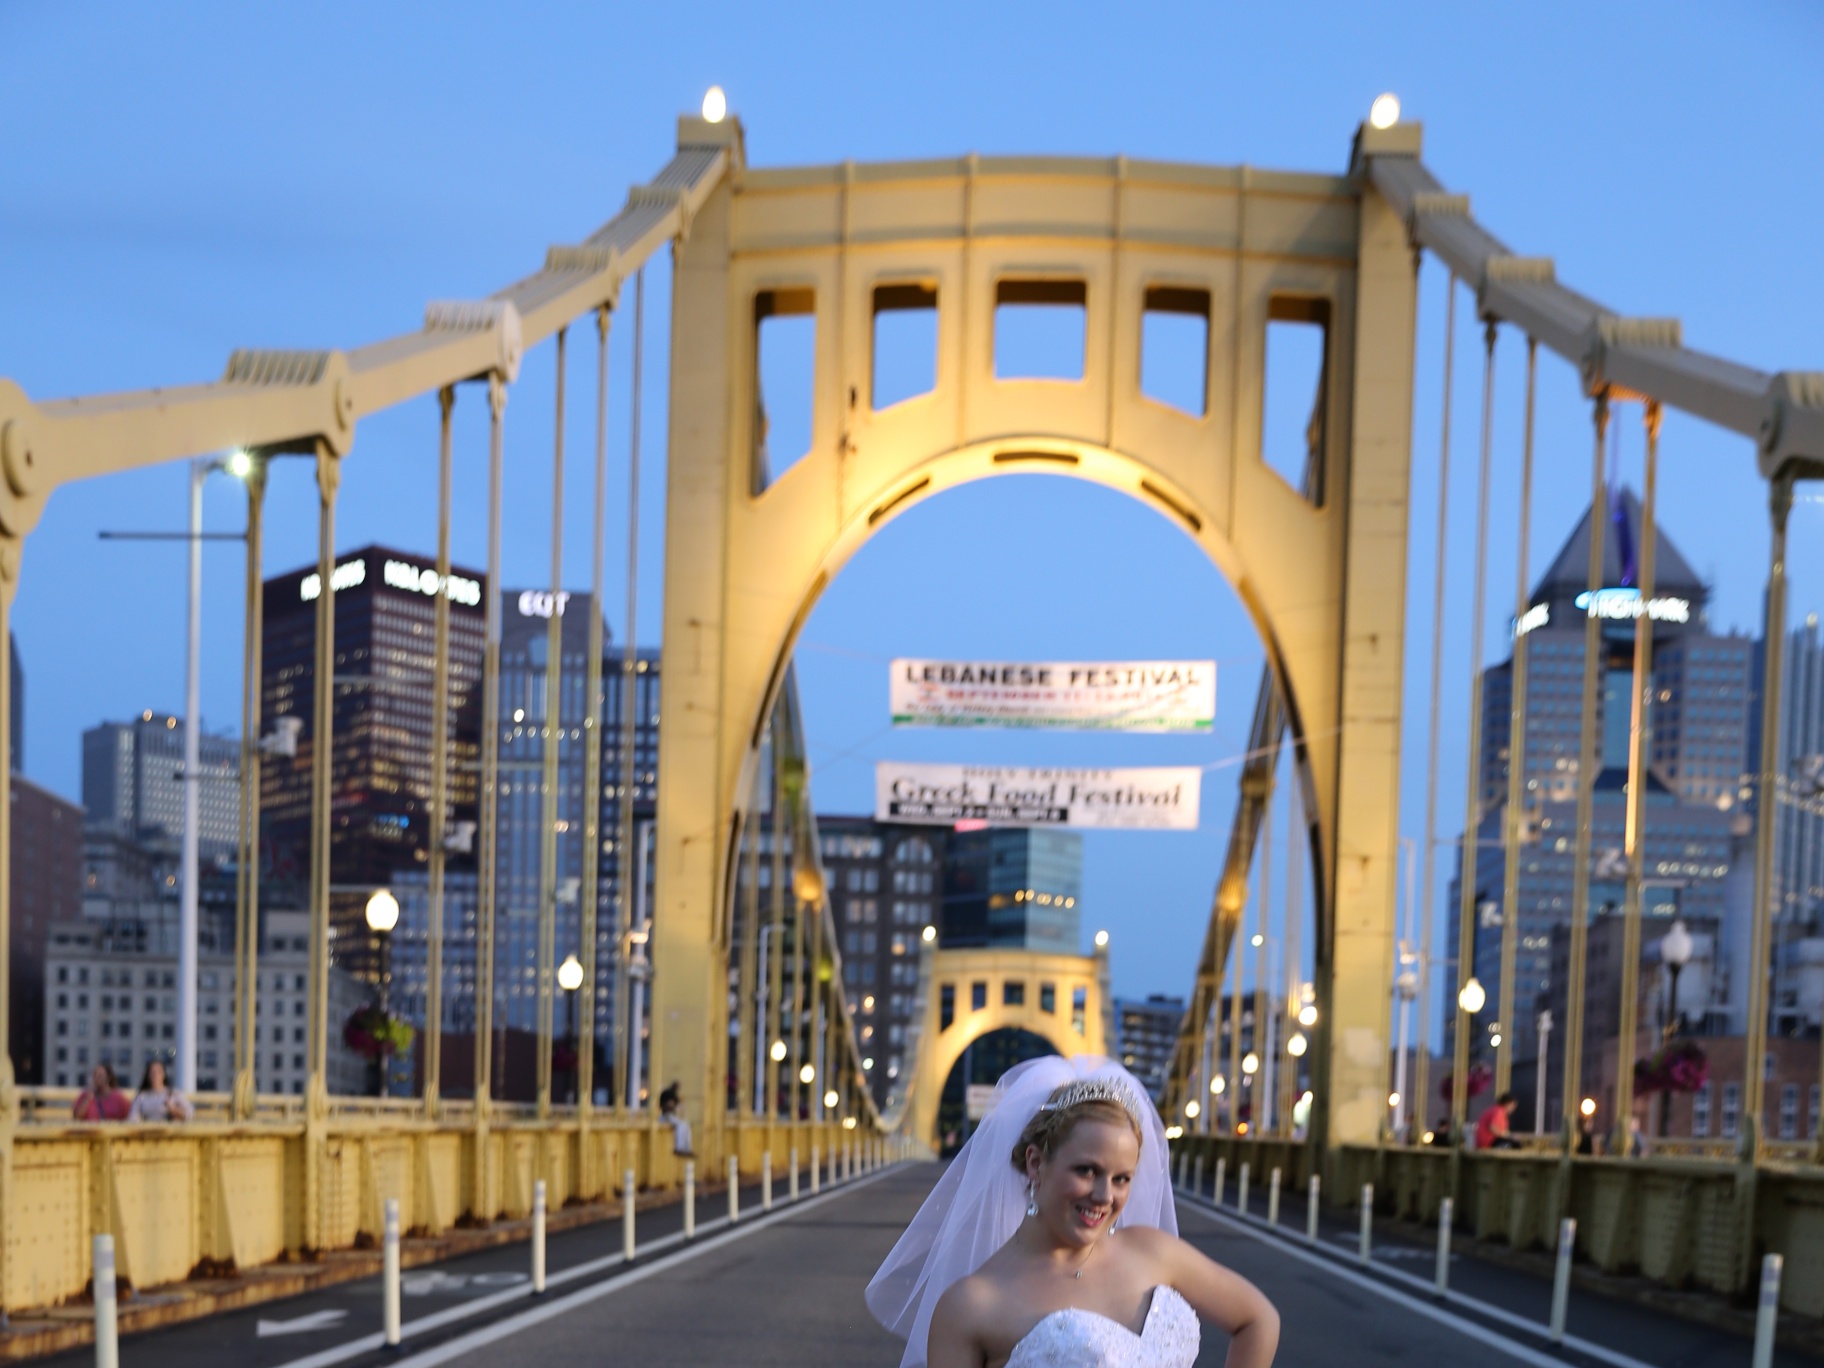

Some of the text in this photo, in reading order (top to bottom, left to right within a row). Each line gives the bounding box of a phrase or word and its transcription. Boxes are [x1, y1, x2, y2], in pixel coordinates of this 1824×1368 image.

[906, 665, 1200, 687] LEBANESE FESTIVAL
[892, 776, 1183, 806] Greek Food Festival
